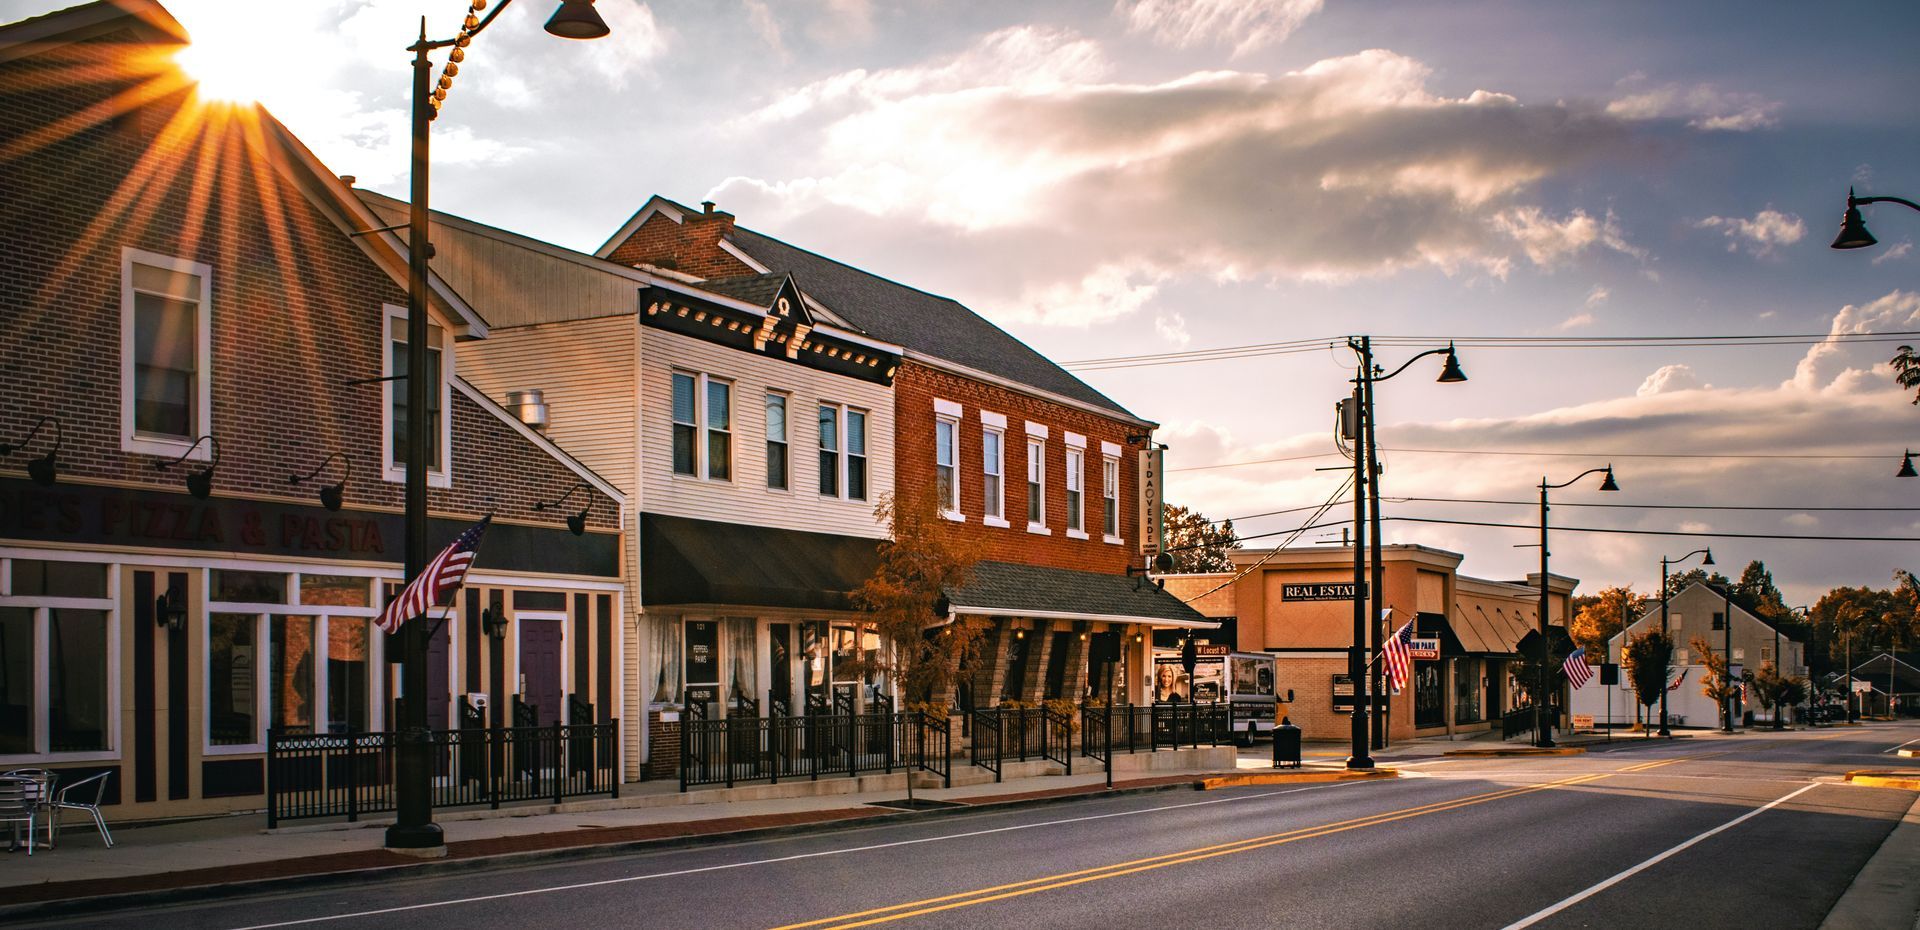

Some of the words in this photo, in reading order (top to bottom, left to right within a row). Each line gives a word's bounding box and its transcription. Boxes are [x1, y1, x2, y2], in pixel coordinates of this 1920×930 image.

[103, 497, 224, 543] PIZZA
[241, 512, 266, 546] &
[282, 513, 384, 553] PASTA
[1286, 586, 1317, 597] REAL
[1320, 585, 1355, 597] ESTAT
[1197, 646, 1202, 654] W
[1203, 646, 1220, 654] Locust
[1220, 646, 1227, 654] St
